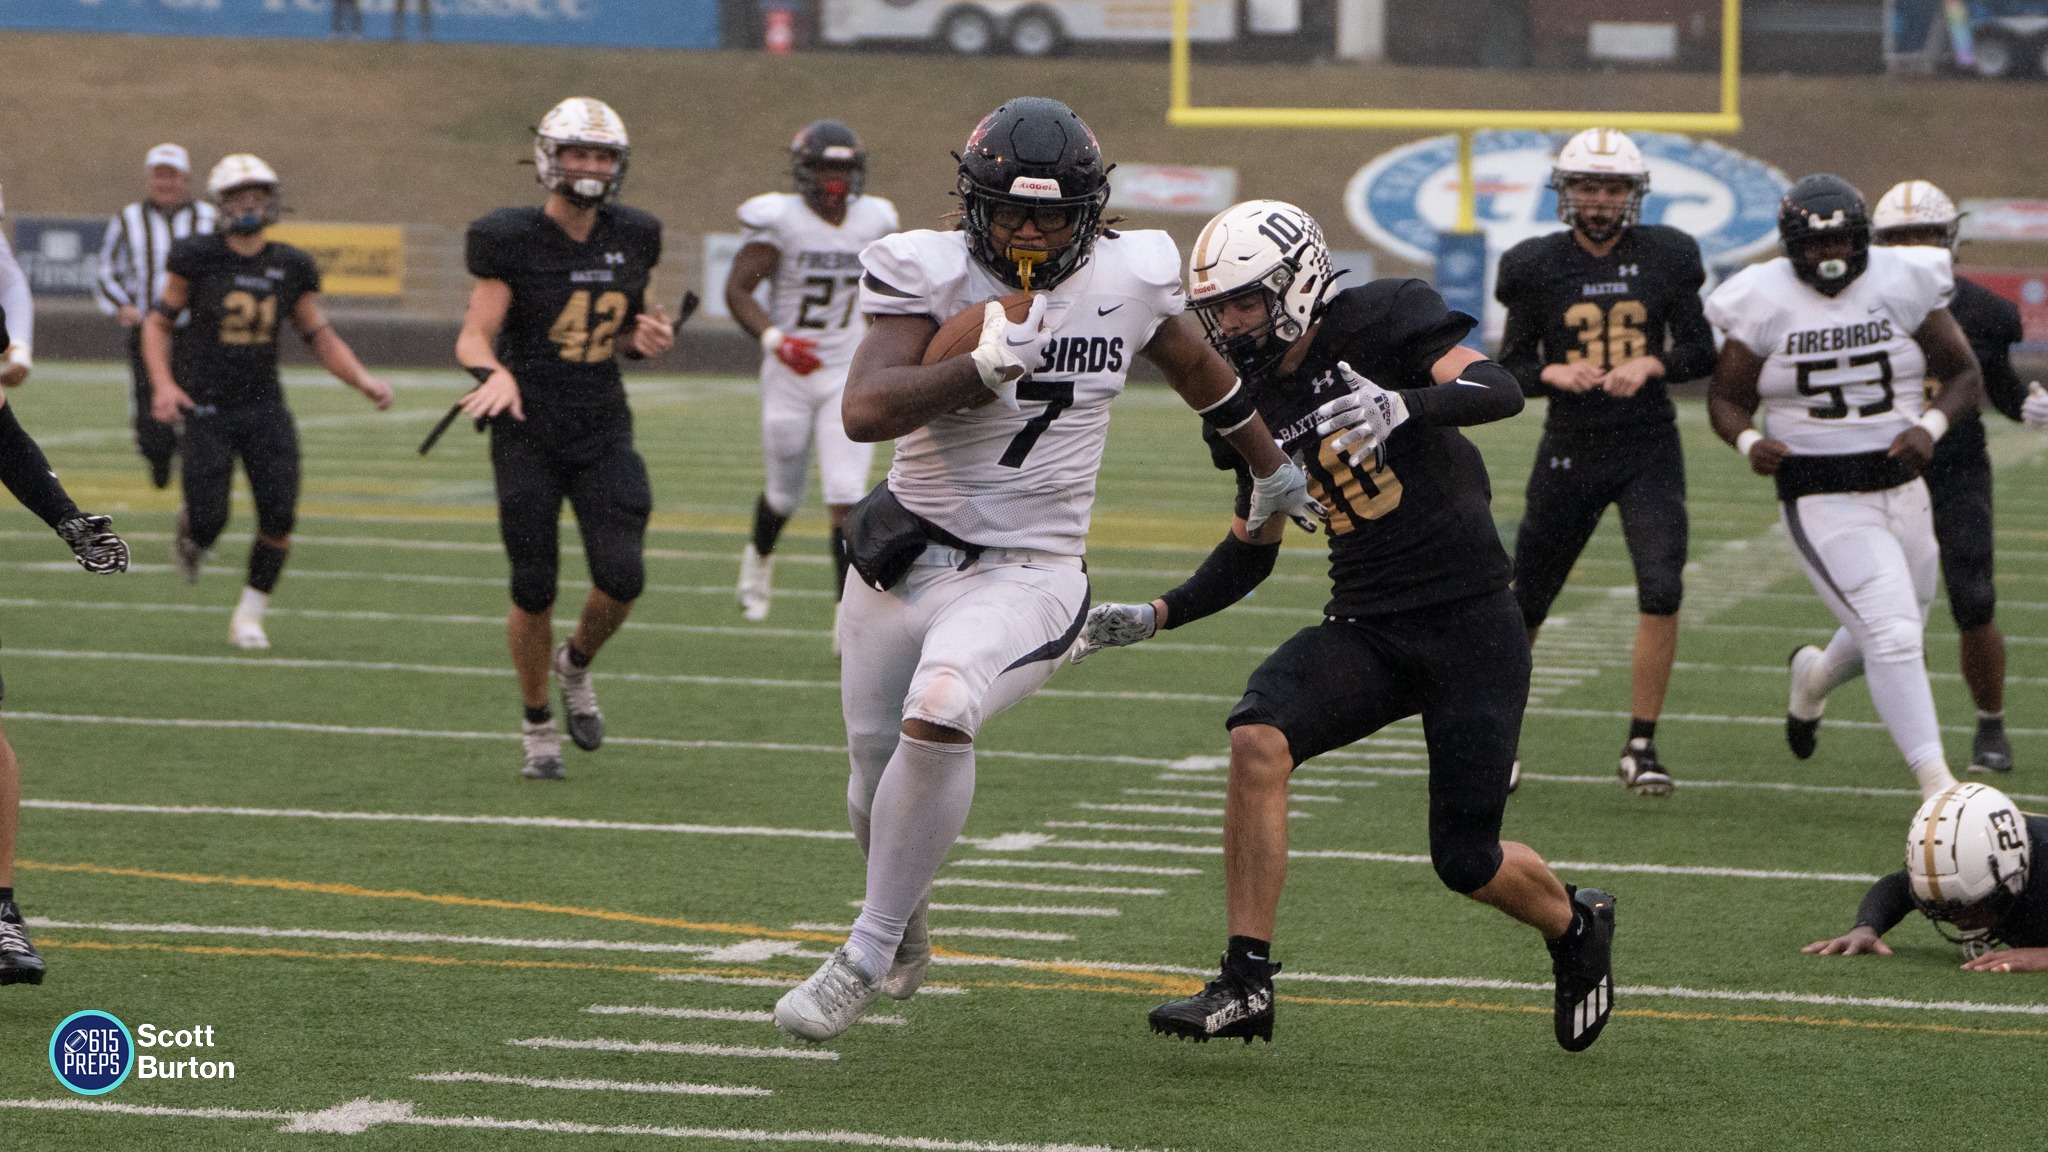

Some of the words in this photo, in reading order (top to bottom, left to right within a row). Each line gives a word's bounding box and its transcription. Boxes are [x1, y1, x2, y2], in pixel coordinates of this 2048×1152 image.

[1258, 212, 1303, 255] 10
[219, 291, 277, 345] 21
[548, 289, 628, 363] 42
[798, 276, 860, 328] 27
[1034, 336, 1124, 373] BIRDS
[1563, 300, 1648, 369] 36
[1786, 319, 1894, 355] FIREBIRDS
[1796, 350, 1894, 420] 53
[998, 380, 1075, 468] 7
[1989, 809, 2026, 851] 23
